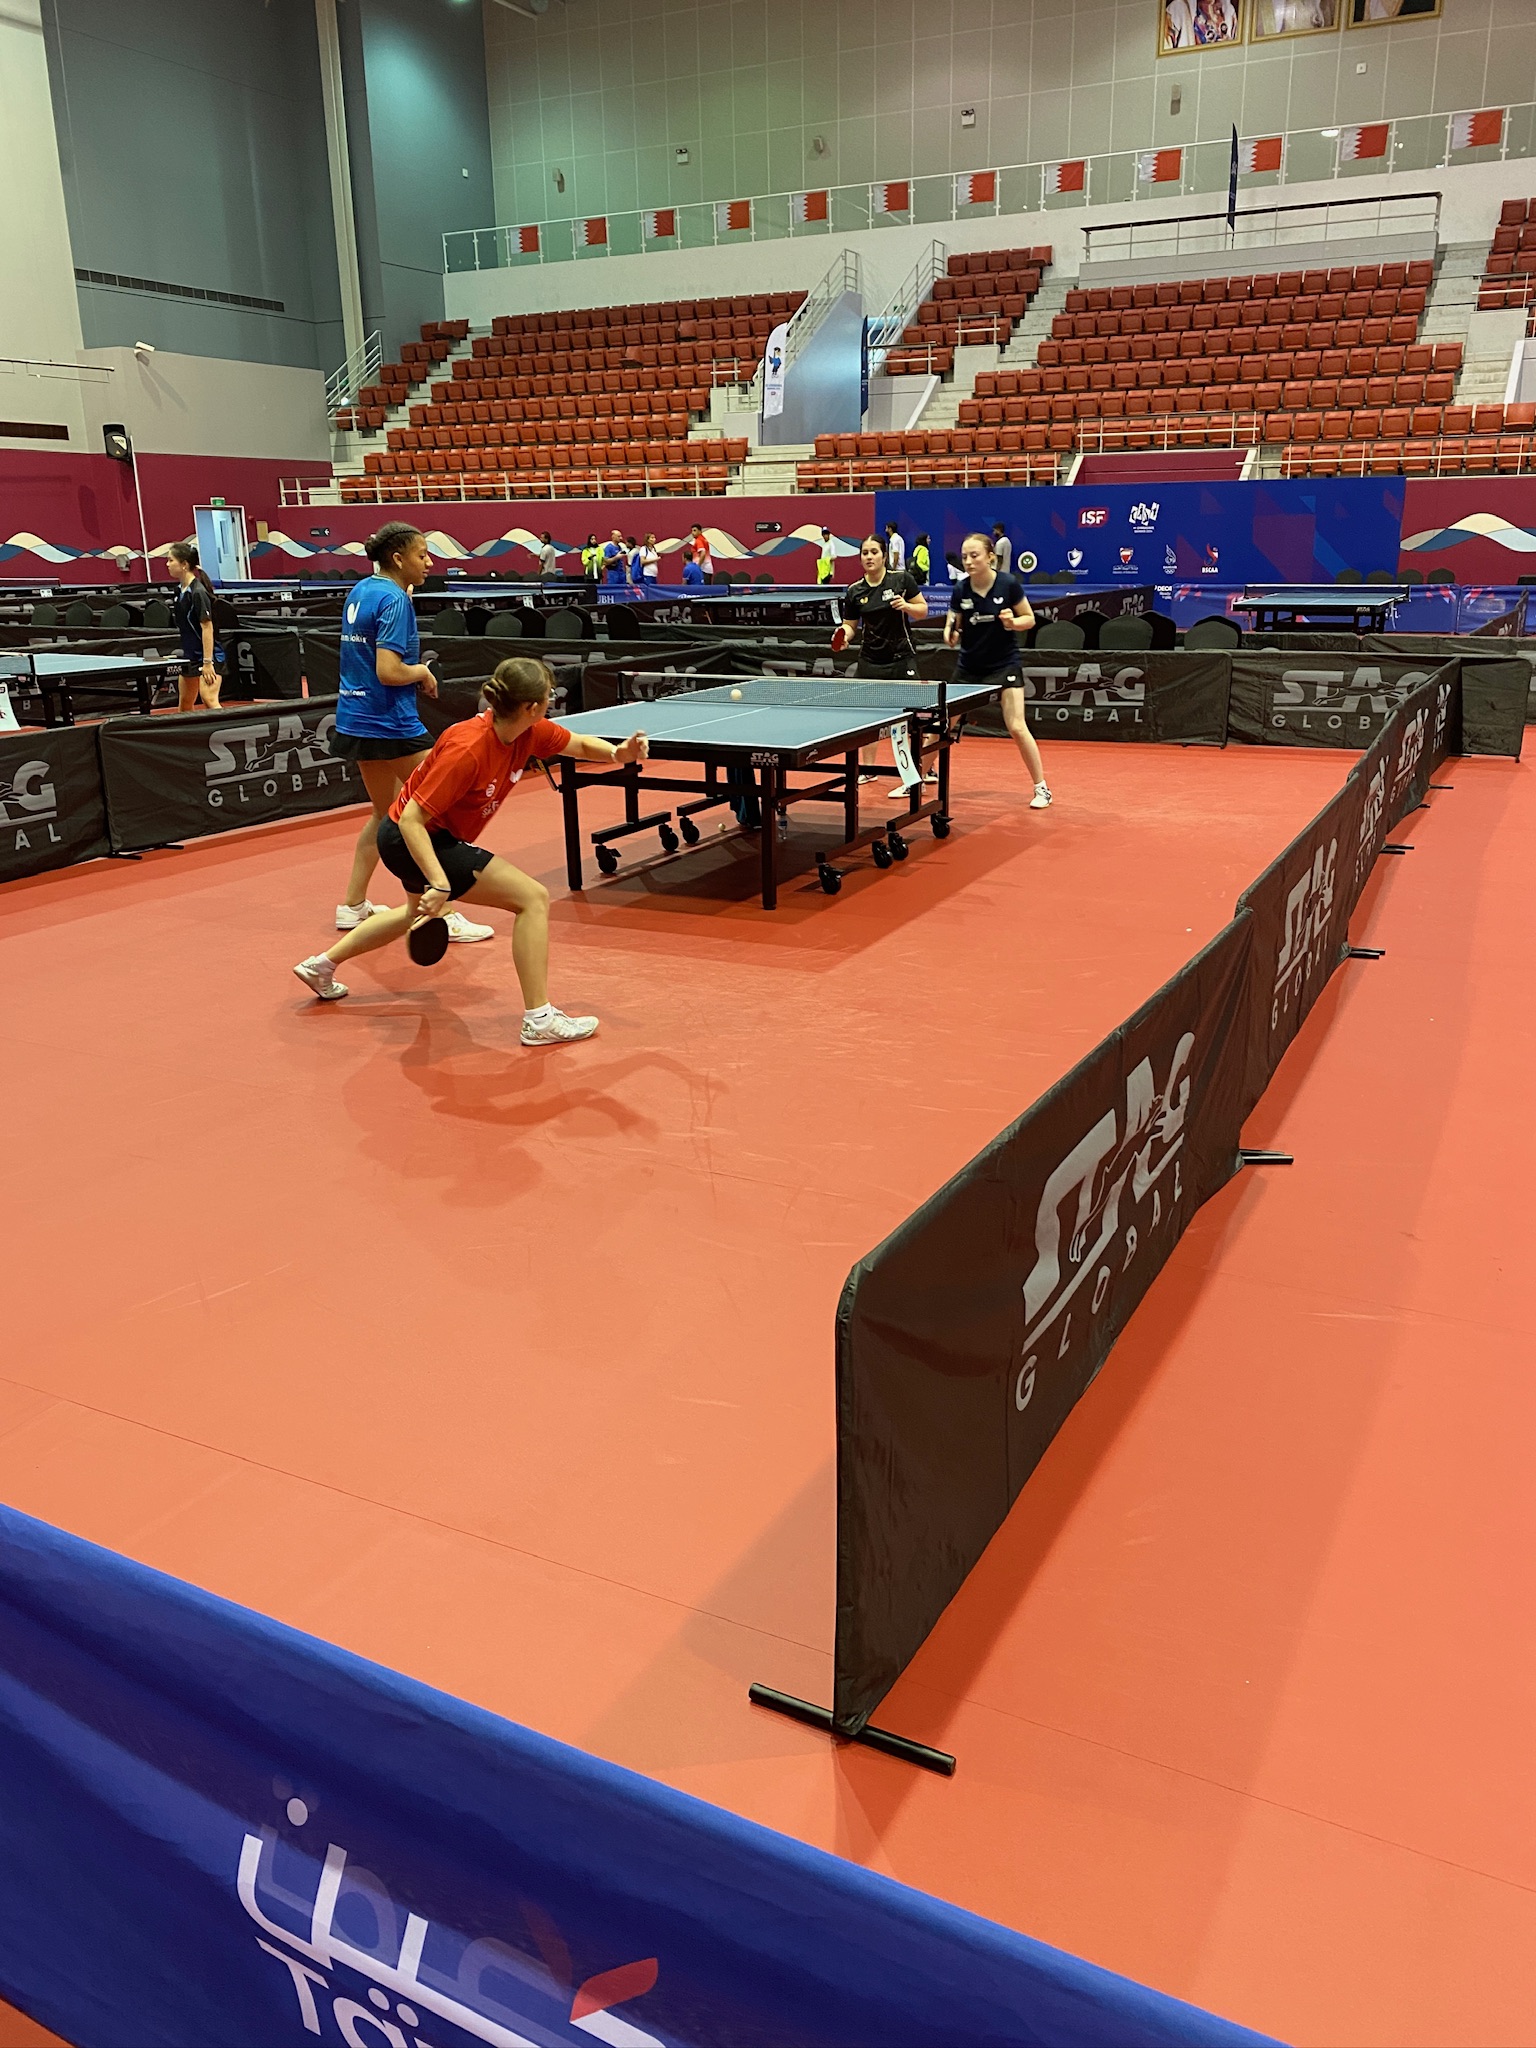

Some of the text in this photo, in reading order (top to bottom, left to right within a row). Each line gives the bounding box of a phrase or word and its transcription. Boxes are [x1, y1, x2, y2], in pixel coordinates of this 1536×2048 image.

[1081, 510, 1106, 525] ISF
[1034, 708, 1143, 722] LOBAL
[1272, 714, 1371, 728] GLOB
[750, 752, 780, 763] STAG
[206, 765, 351, 808] GLOBAL
[1022, 1032, 1195, 1335] STAG
[1015, 1160, 1182, 1412] GLOBAL
